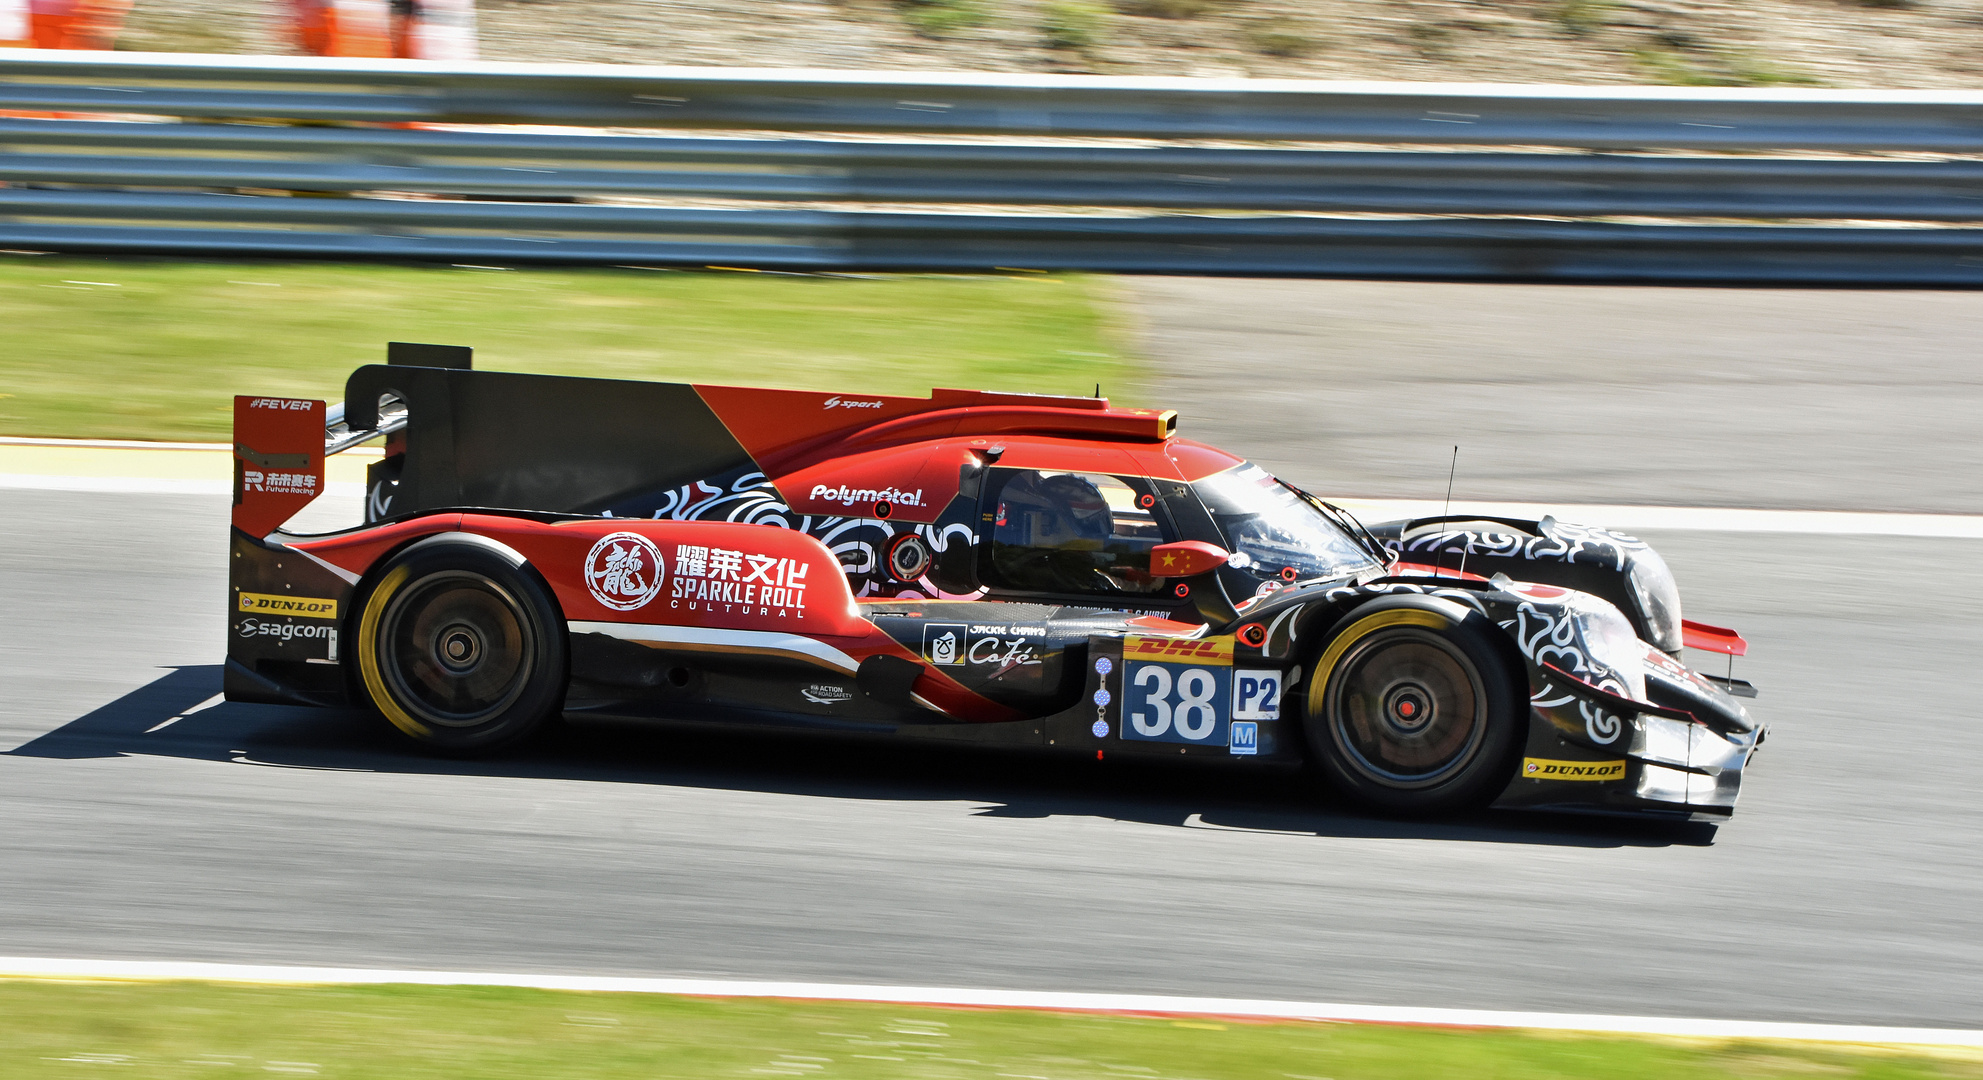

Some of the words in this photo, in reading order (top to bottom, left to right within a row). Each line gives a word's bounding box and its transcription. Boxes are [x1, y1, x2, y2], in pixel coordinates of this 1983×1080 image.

[250, 398, 312, 411] #FEVER
[841, 401, 884, 409] spark
[290, 487, 314, 496] Racing
[674, 544, 809, 589] 耀莱文化
[671, 577, 756, 604] SPARKLE
[760, 585, 806, 609] ROLL
[256, 598, 333, 613] DUNLOP
[670, 600, 804, 619] CULTURAL
[1137, 637, 1221, 658] DHL
[820, 685, 843, 693] ACTION
[1238, 677, 1277, 712] P2
[1131, 665, 1216, 740] 38
[1235, 727, 1255, 745] M
[1543, 765, 1622, 775] DUNLOP
